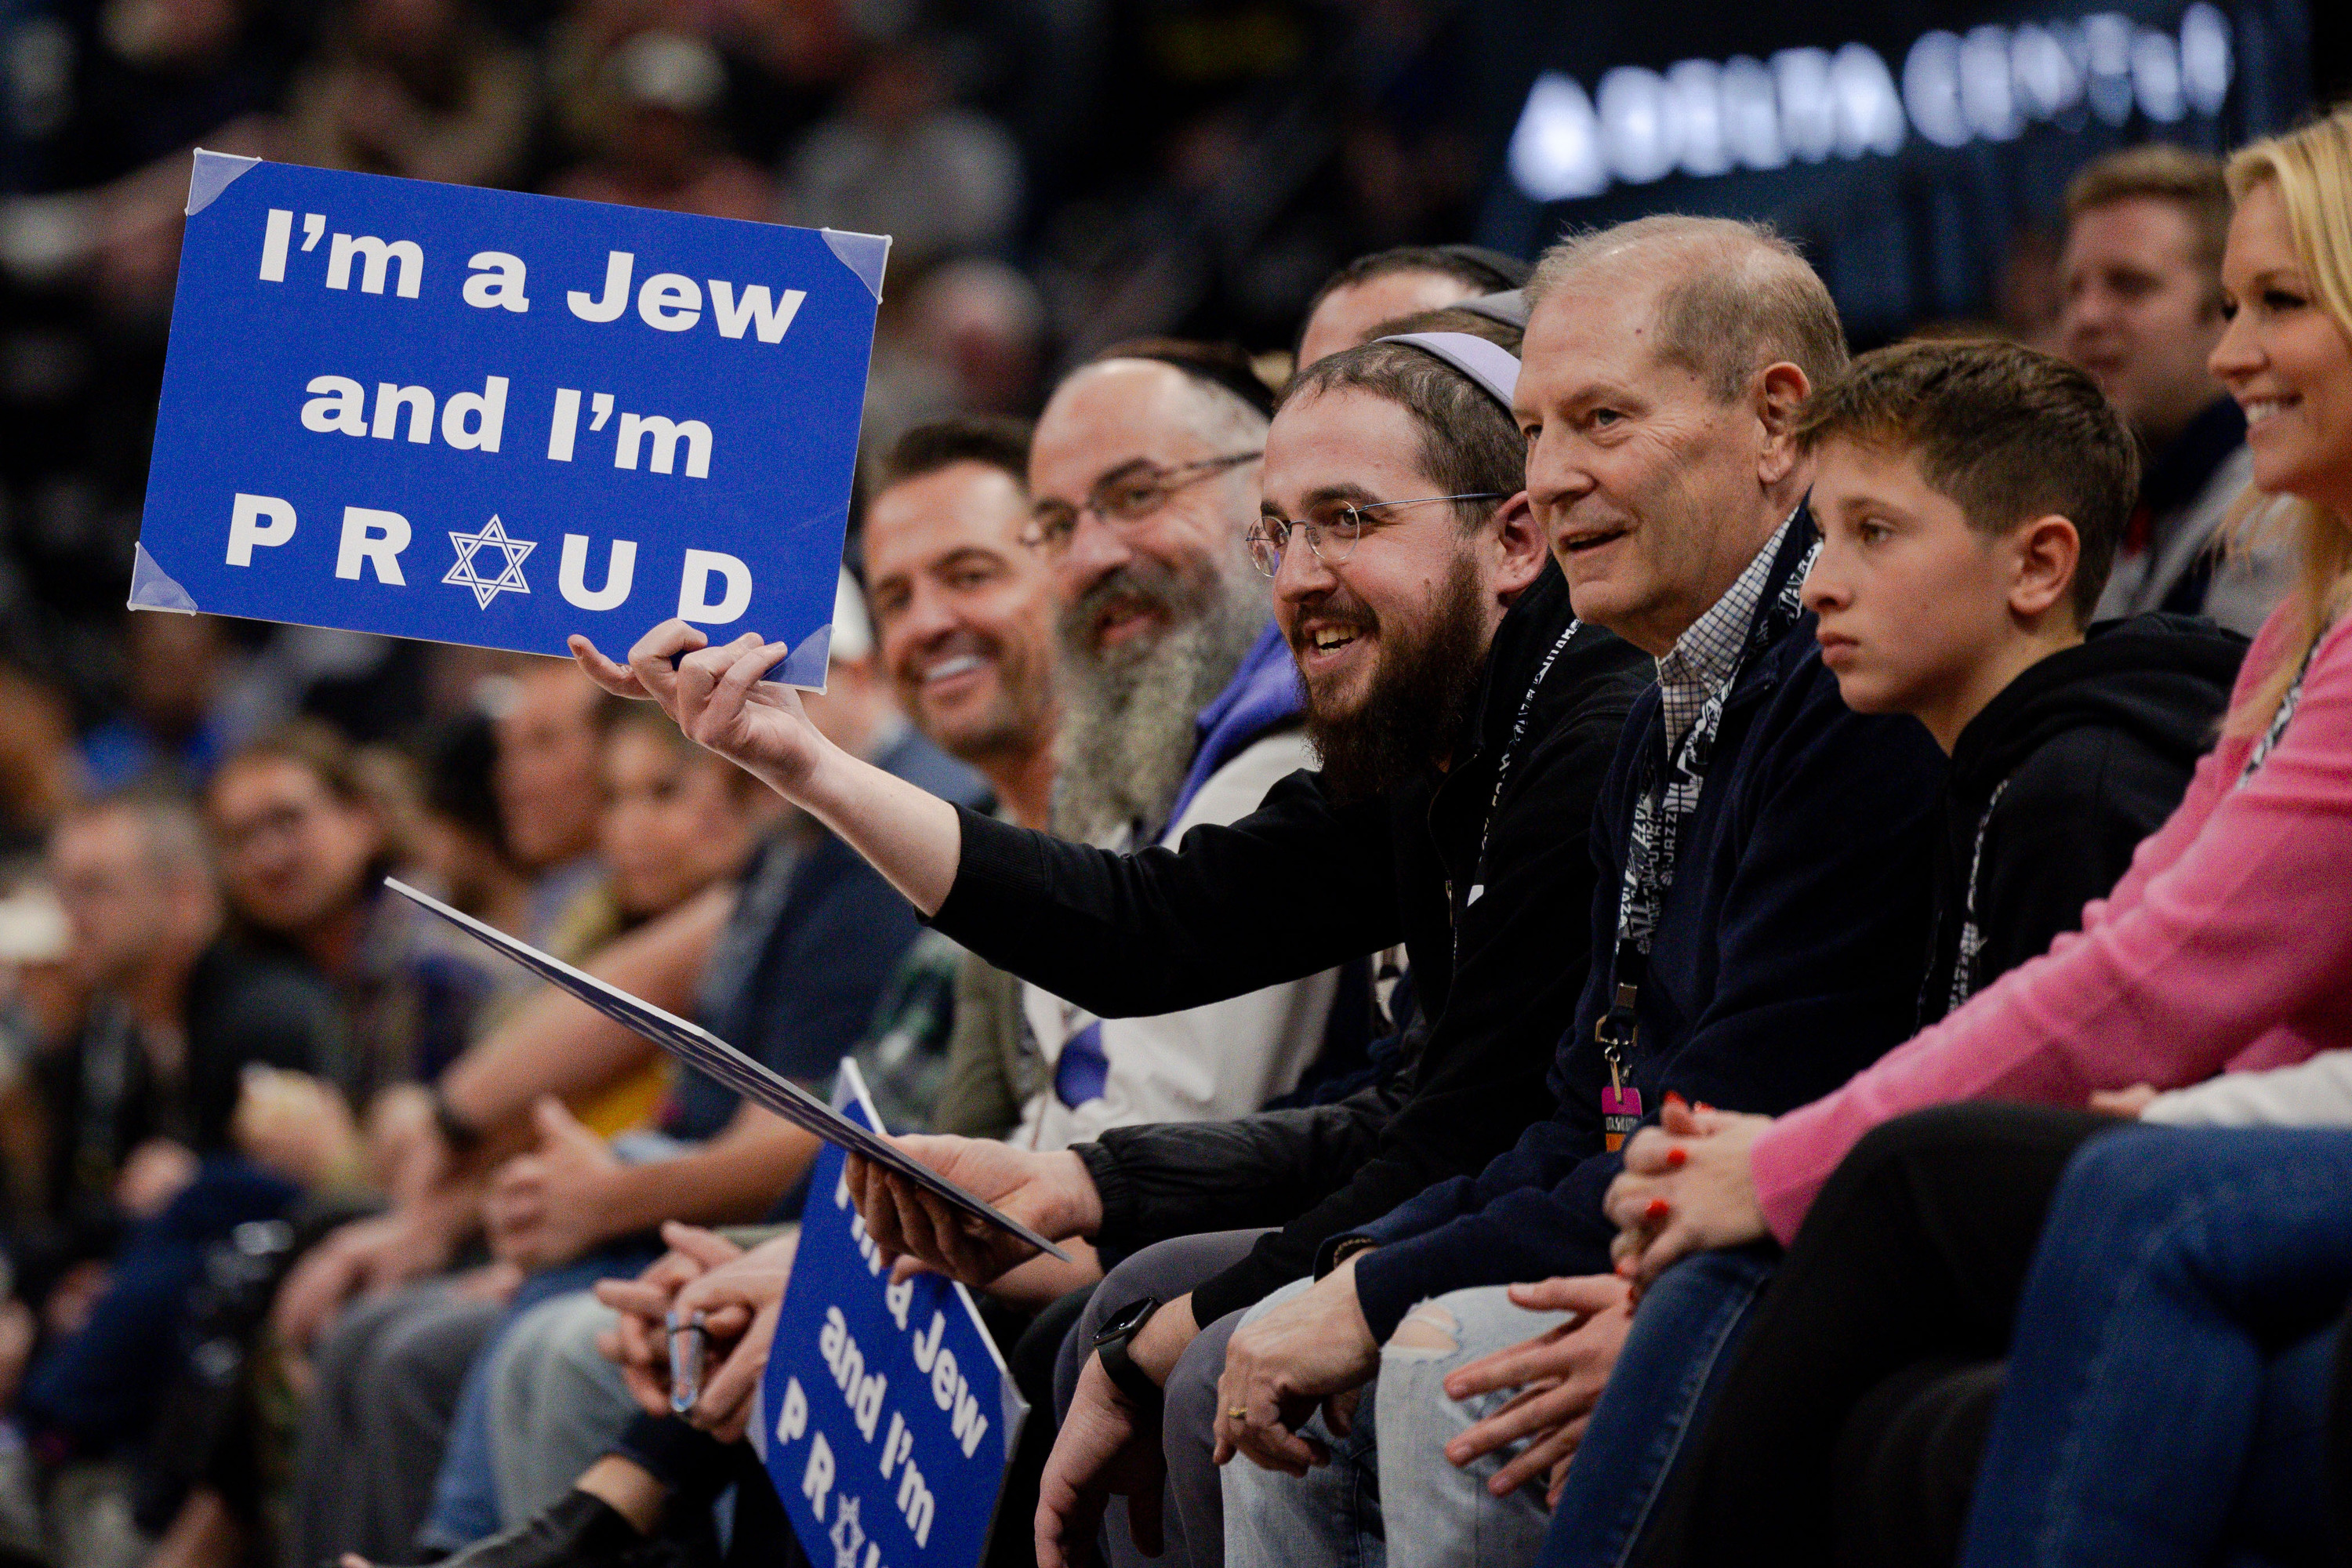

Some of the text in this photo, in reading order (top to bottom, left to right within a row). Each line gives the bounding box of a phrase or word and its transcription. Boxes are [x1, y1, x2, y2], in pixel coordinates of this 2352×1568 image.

[259, 209, 808, 344] I’m a Jew
[300, 375, 713, 479] and I’m
[819, 1305, 935, 1549] and I’m
[913, 1310, 989, 1459] Jew
